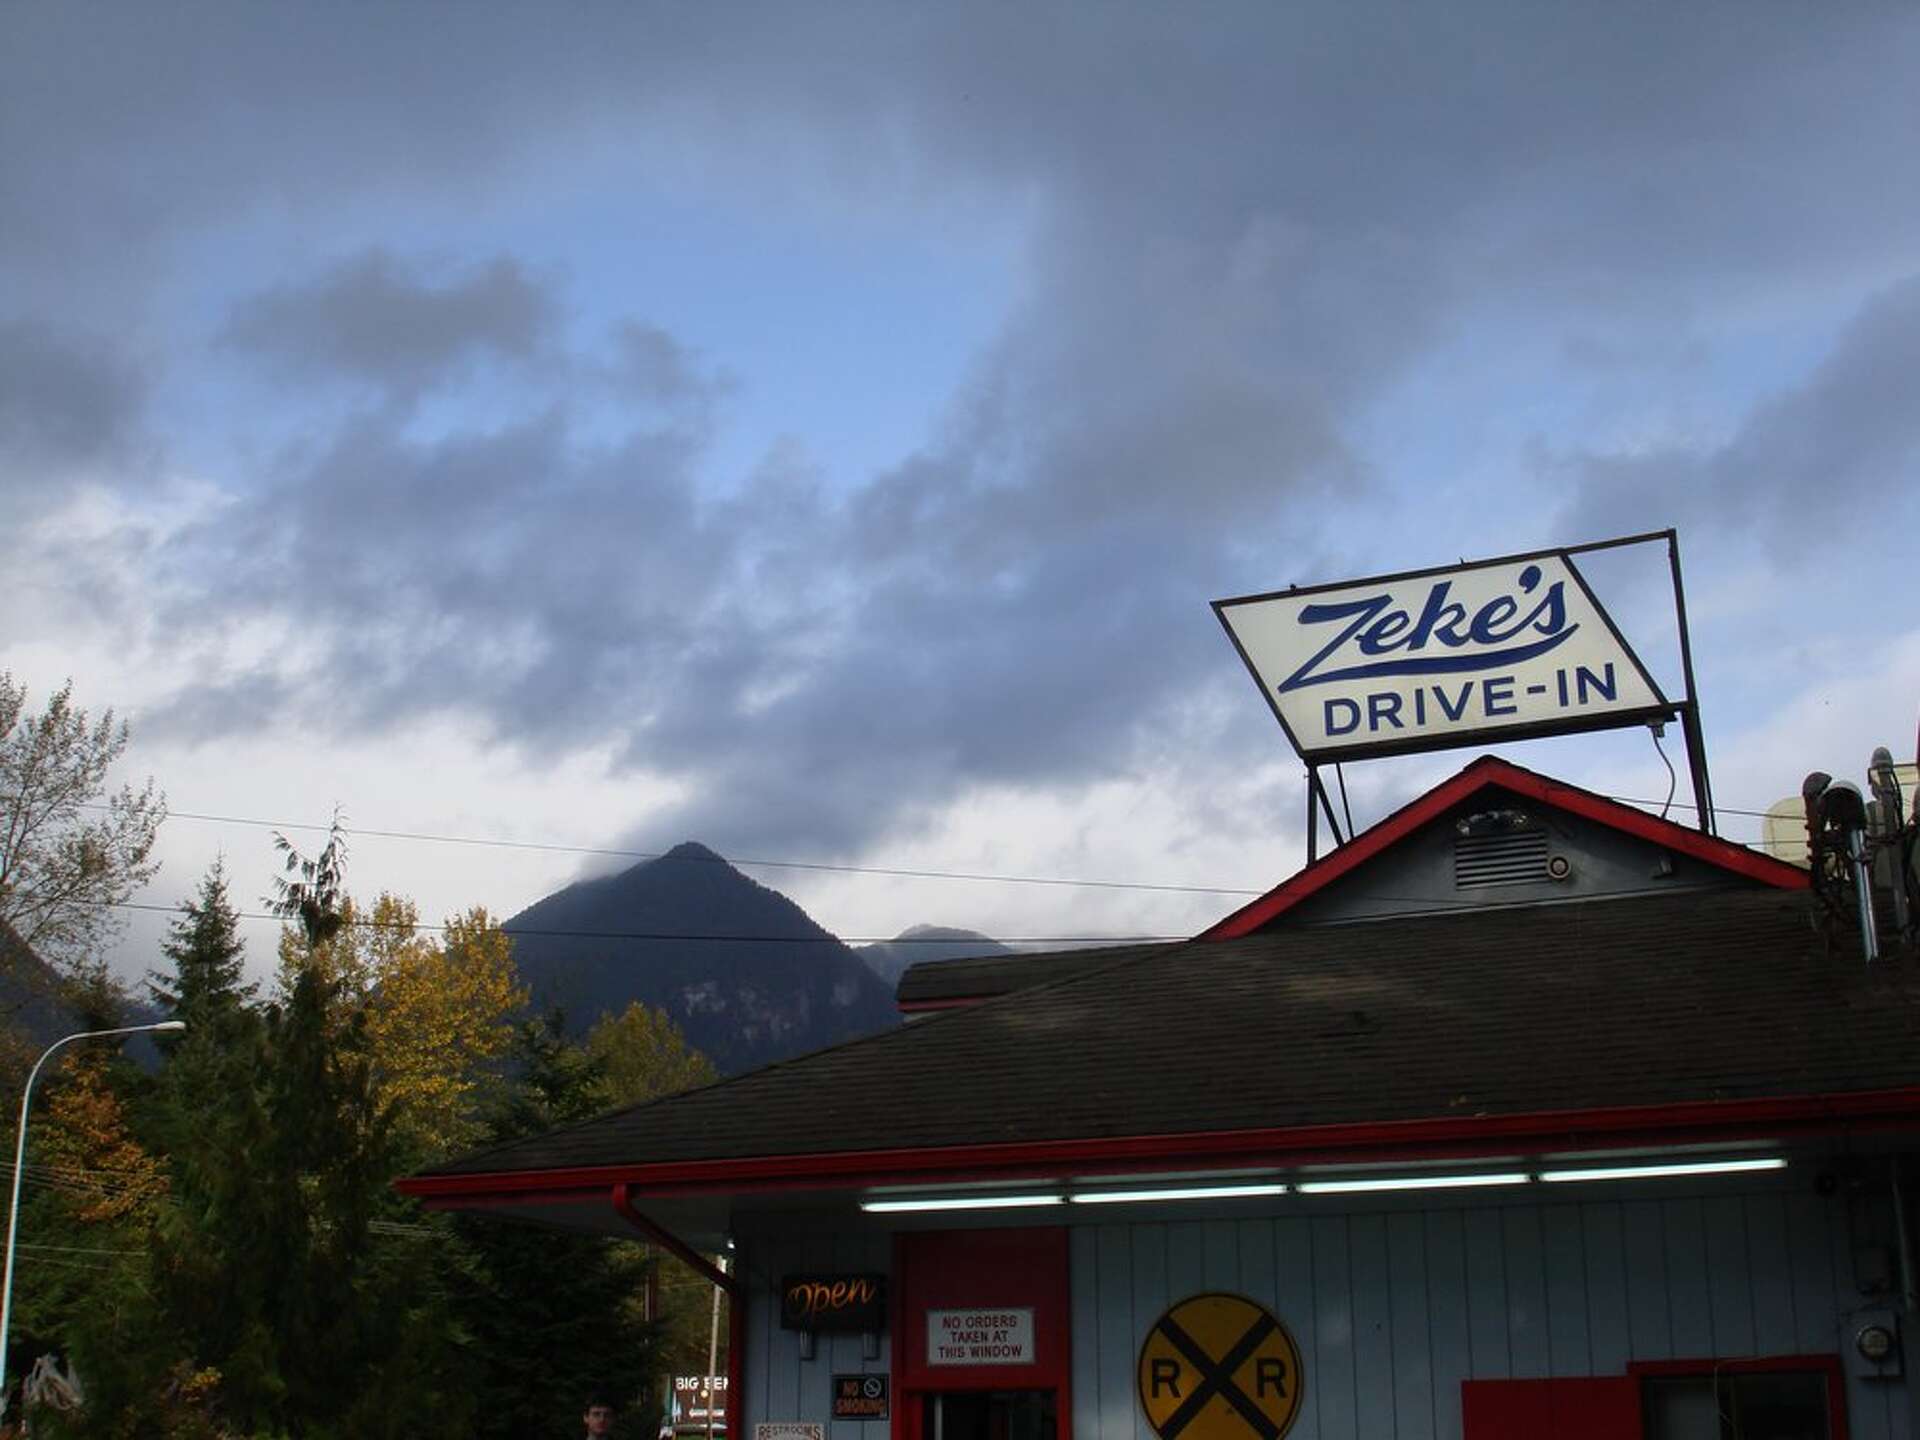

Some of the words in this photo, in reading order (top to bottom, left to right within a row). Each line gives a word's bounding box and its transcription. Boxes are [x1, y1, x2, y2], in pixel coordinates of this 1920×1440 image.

[1277, 565, 1580, 693] Zeke's
[1324, 662, 1617, 737] DRIVE-IN
[943, 1316, 961, 1329] NO
[966, 1314, 1017, 1328] ORDERS
[951, 1331, 988, 1343] TAKEN
[993, 1330, 1009, 1342] AT
[938, 1346, 965, 1359] THIS
[970, 1344, 1022, 1358] WINDOW
[675, 1376, 699, 1391] BIG
[1152, 1359, 1180, 1398] R
[1257, 1358, 1286, 1397] R
[759, 1425, 822, 1439] RESTROOMS
